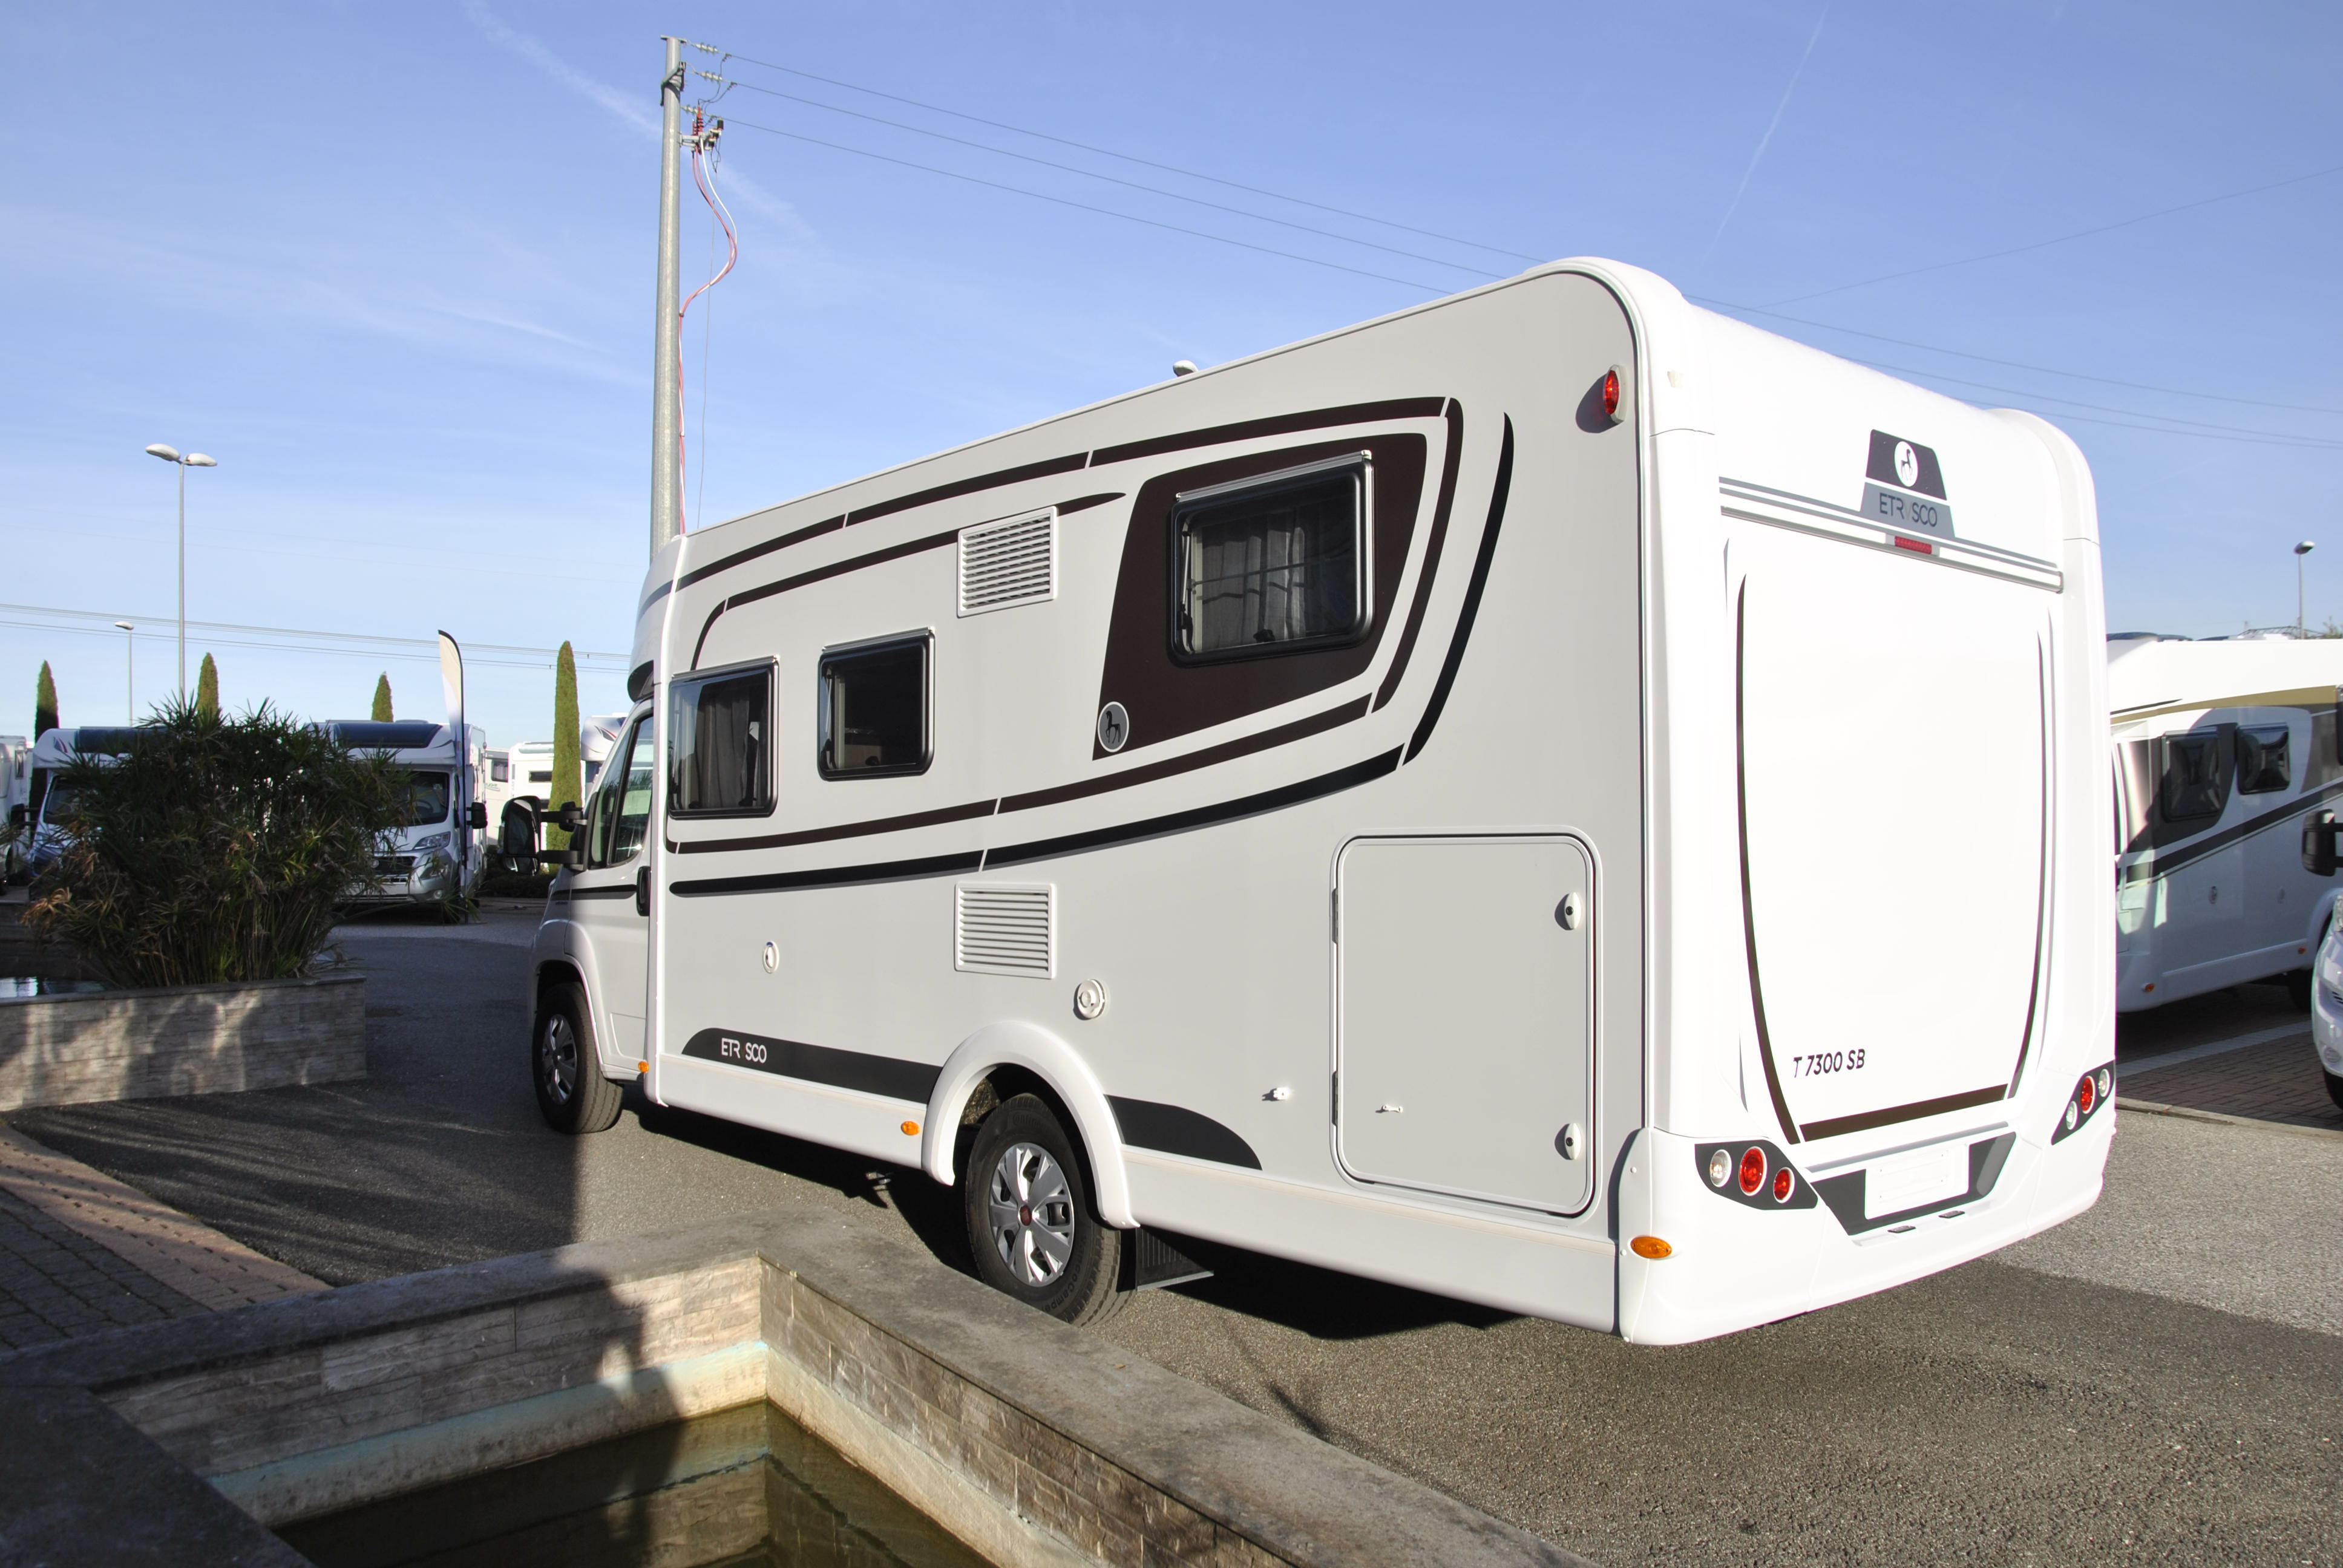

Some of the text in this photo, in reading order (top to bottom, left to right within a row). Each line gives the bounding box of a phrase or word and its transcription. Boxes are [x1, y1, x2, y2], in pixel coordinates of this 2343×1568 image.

[1793, 1048, 1866, 1078] T 7300 SB
